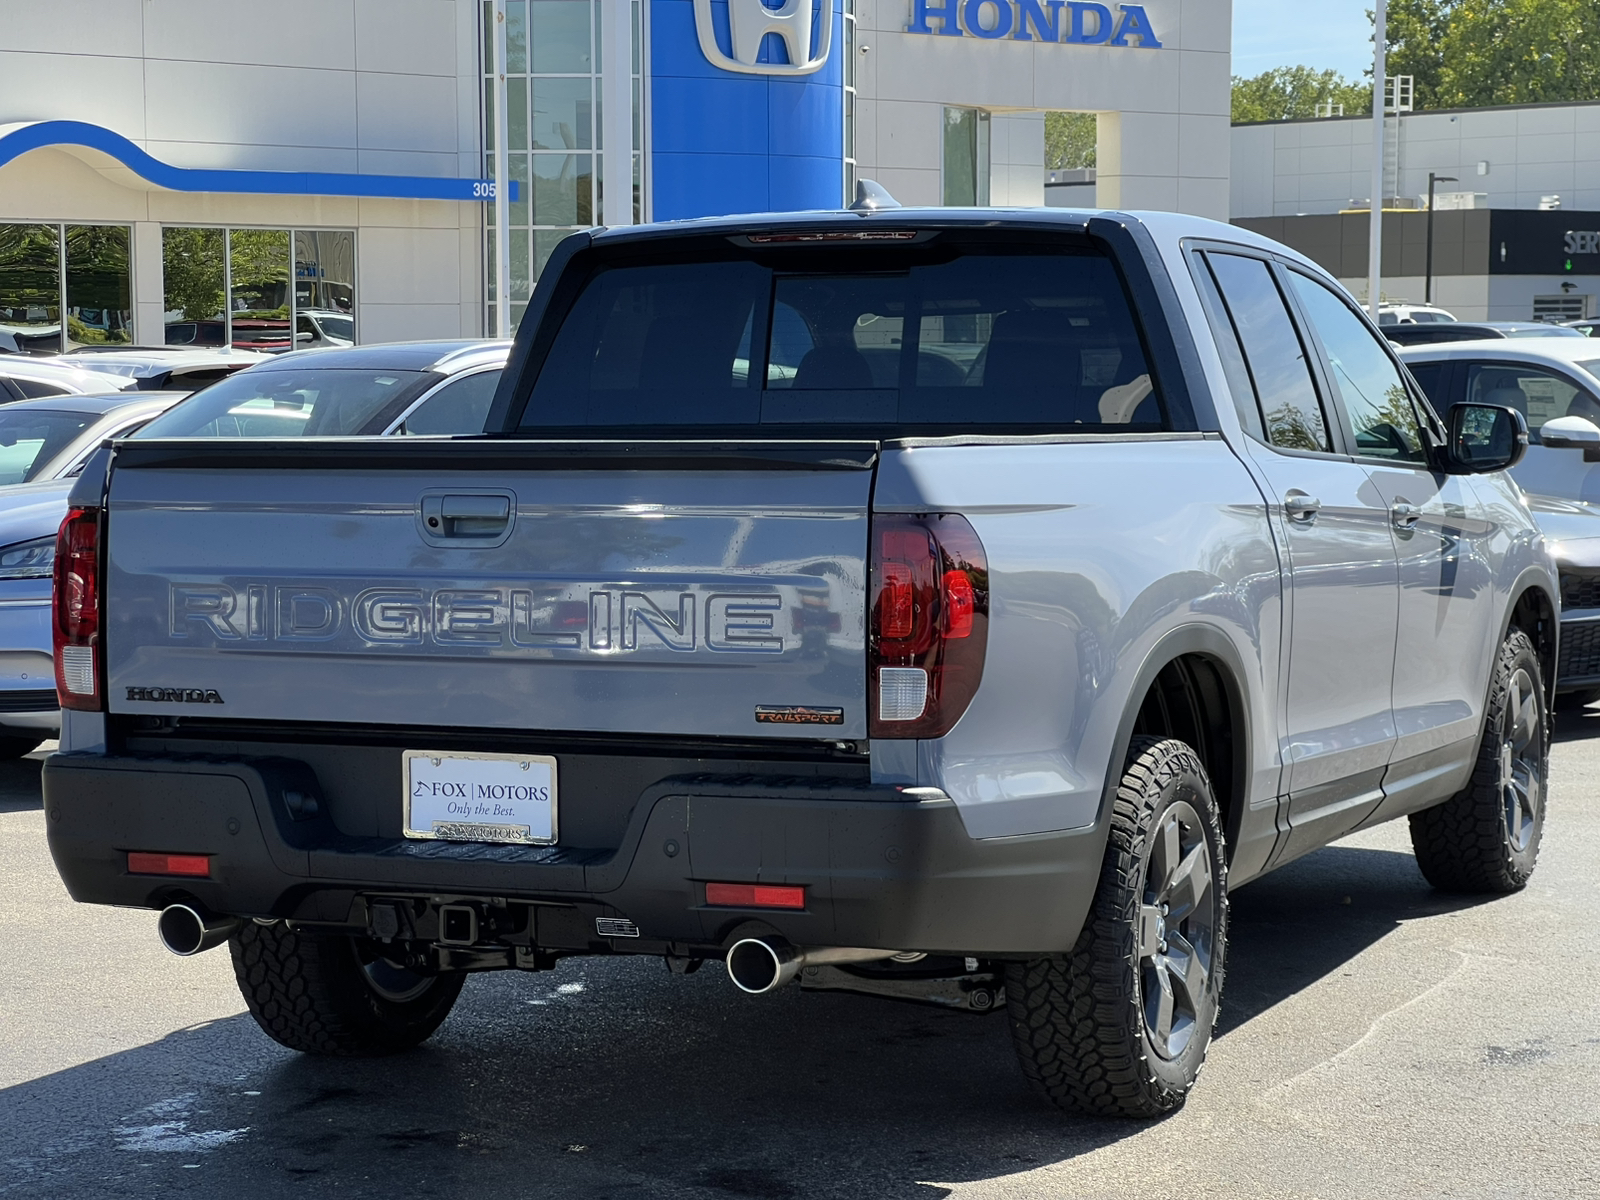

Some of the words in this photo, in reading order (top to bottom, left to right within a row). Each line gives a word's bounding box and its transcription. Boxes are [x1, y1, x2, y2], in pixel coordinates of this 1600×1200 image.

[903, 0, 1163, 48] HONDA
[472, 182, 496, 197] 305
[1564, 230, 1600, 254] SER
[167, 581, 785, 654] RIDGELINE
[125, 686, 225, 704] HONDA
[757, 713, 840, 723] TRAILSPORT
[432, 782, 466, 798] FOX
[478, 785, 548, 801] MOTORS
[447, 802, 472, 818] Only
[474, 803, 490, 816] the
[493, 804, 515, 817] Best.
